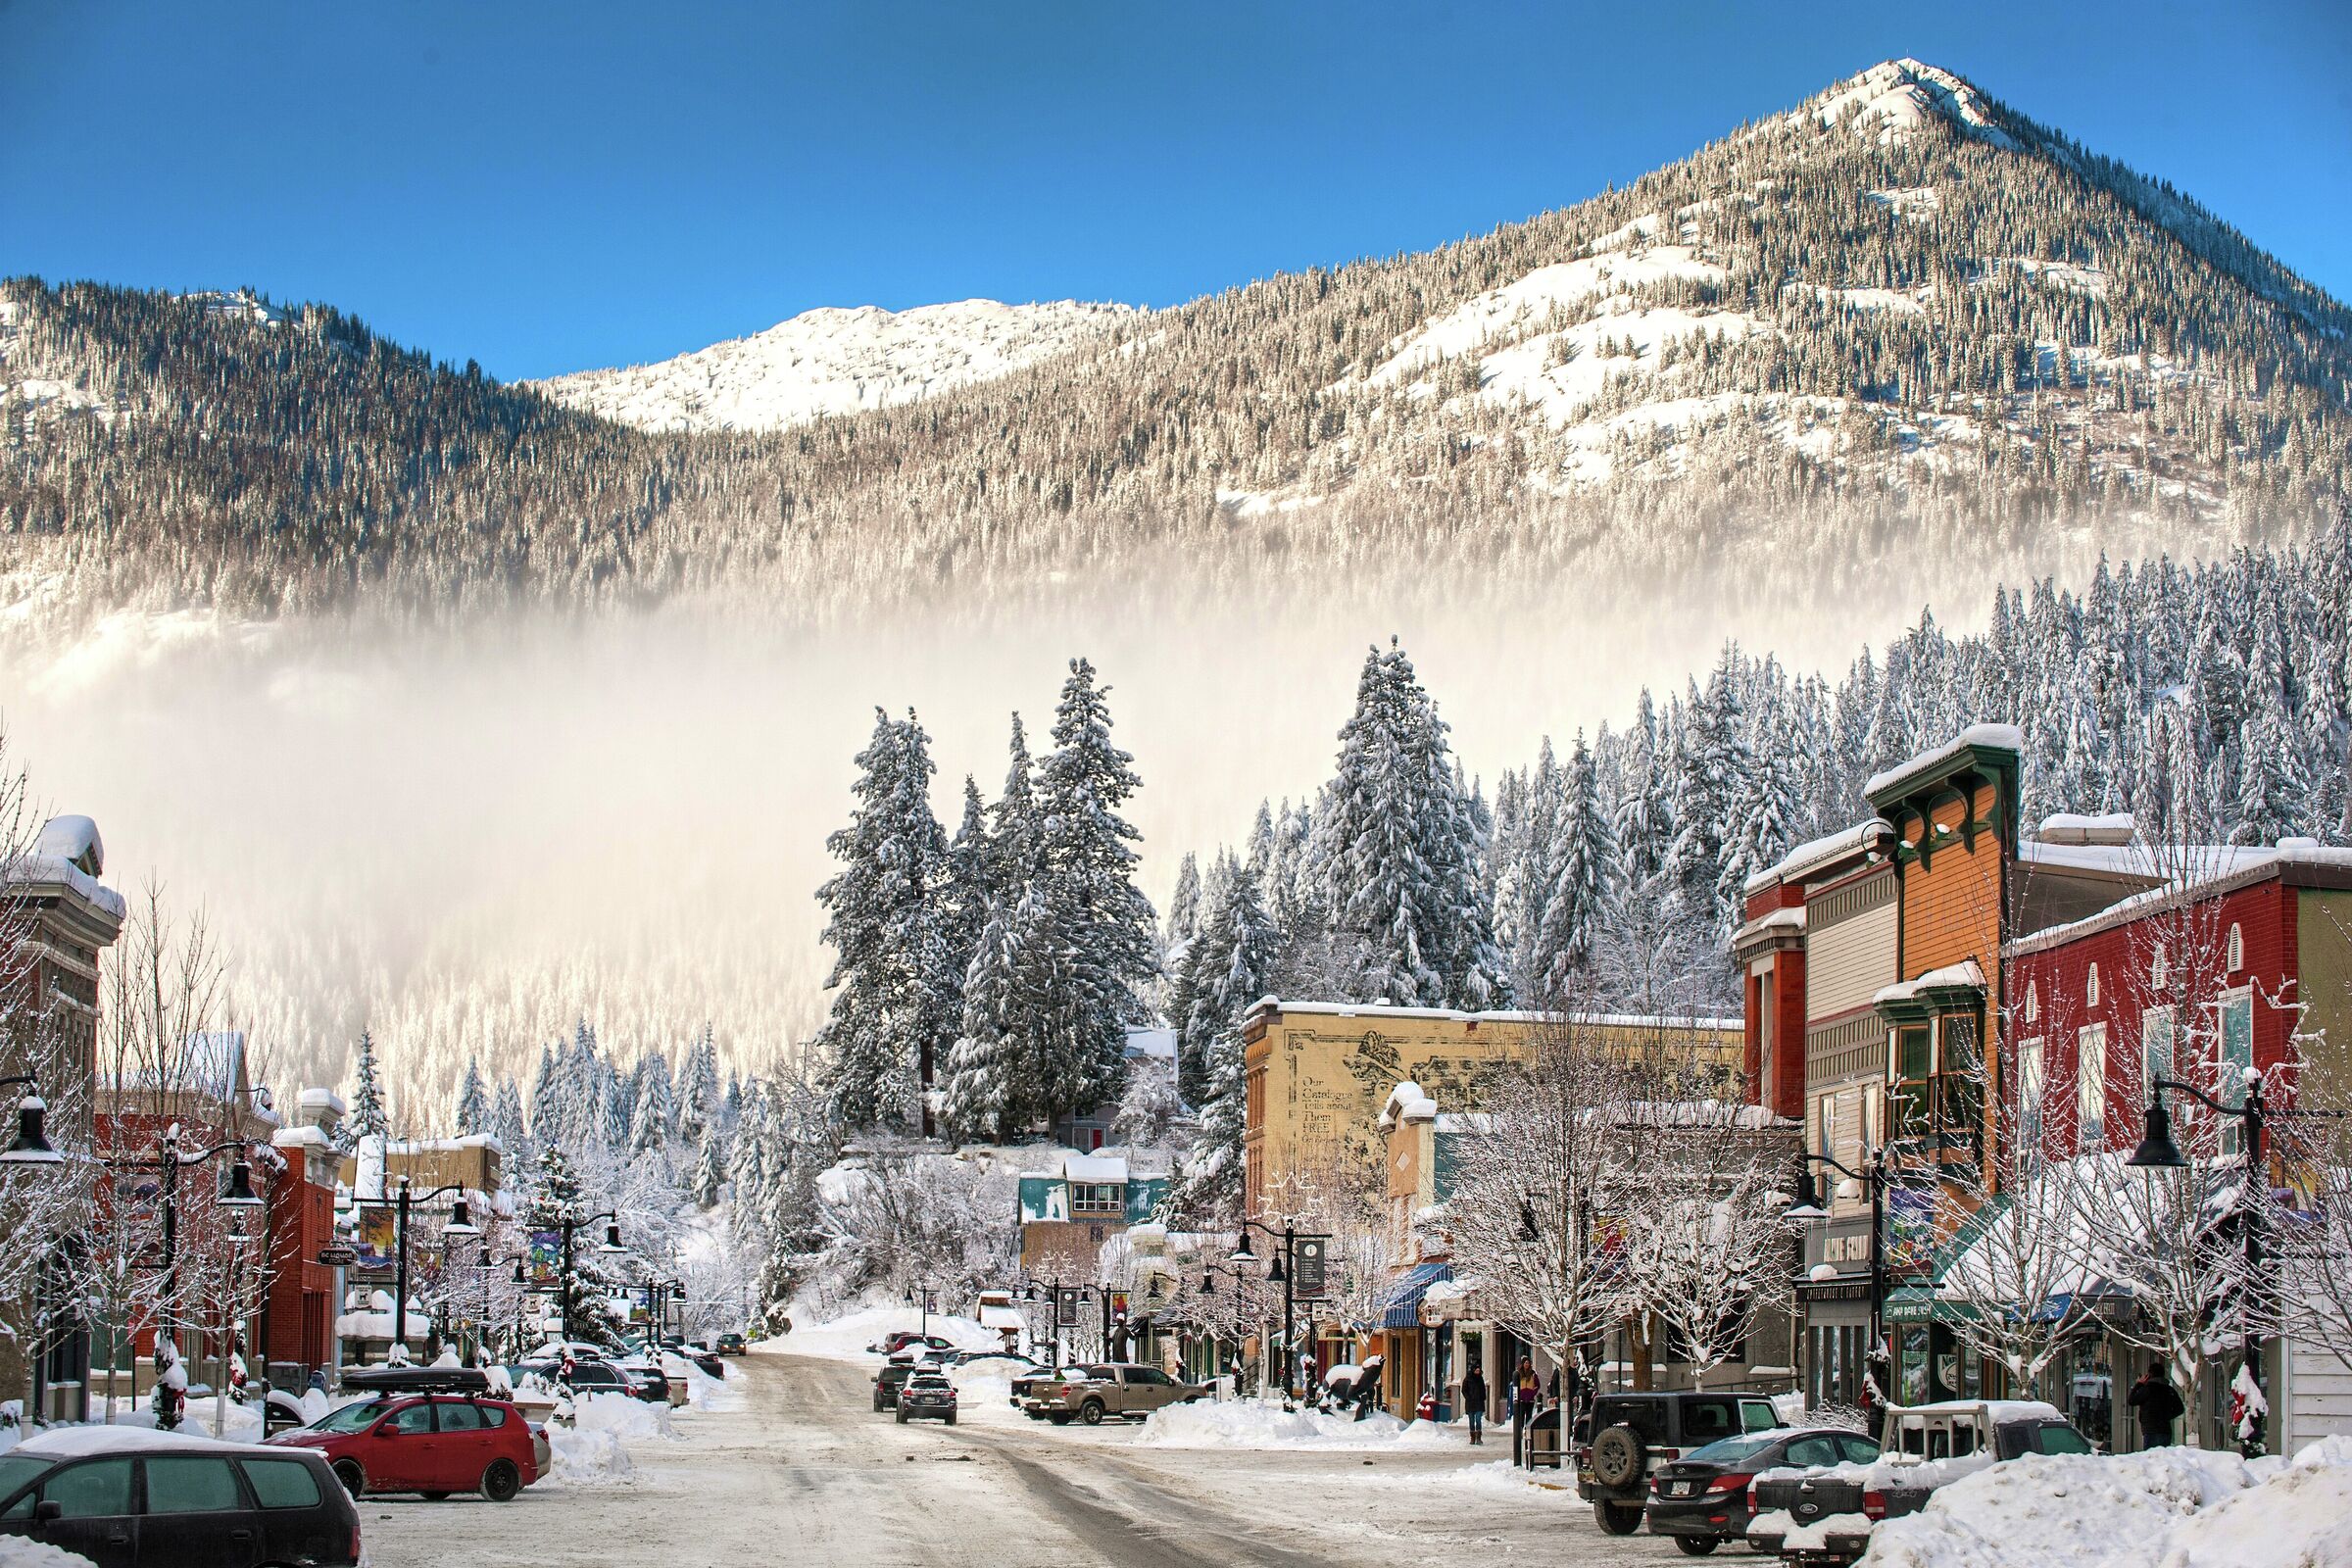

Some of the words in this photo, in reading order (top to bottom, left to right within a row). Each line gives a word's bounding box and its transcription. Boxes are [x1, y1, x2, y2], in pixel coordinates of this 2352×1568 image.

[1301, 1076, 1324, 1088] Our
[1301, 1088, 1353, 1101] Catalogue
[1301, 1100, 1324, 1110] Tells
[1301, 1111, 1331, 1122] Them
[1301, 1122, 1330, 1133] FREE
